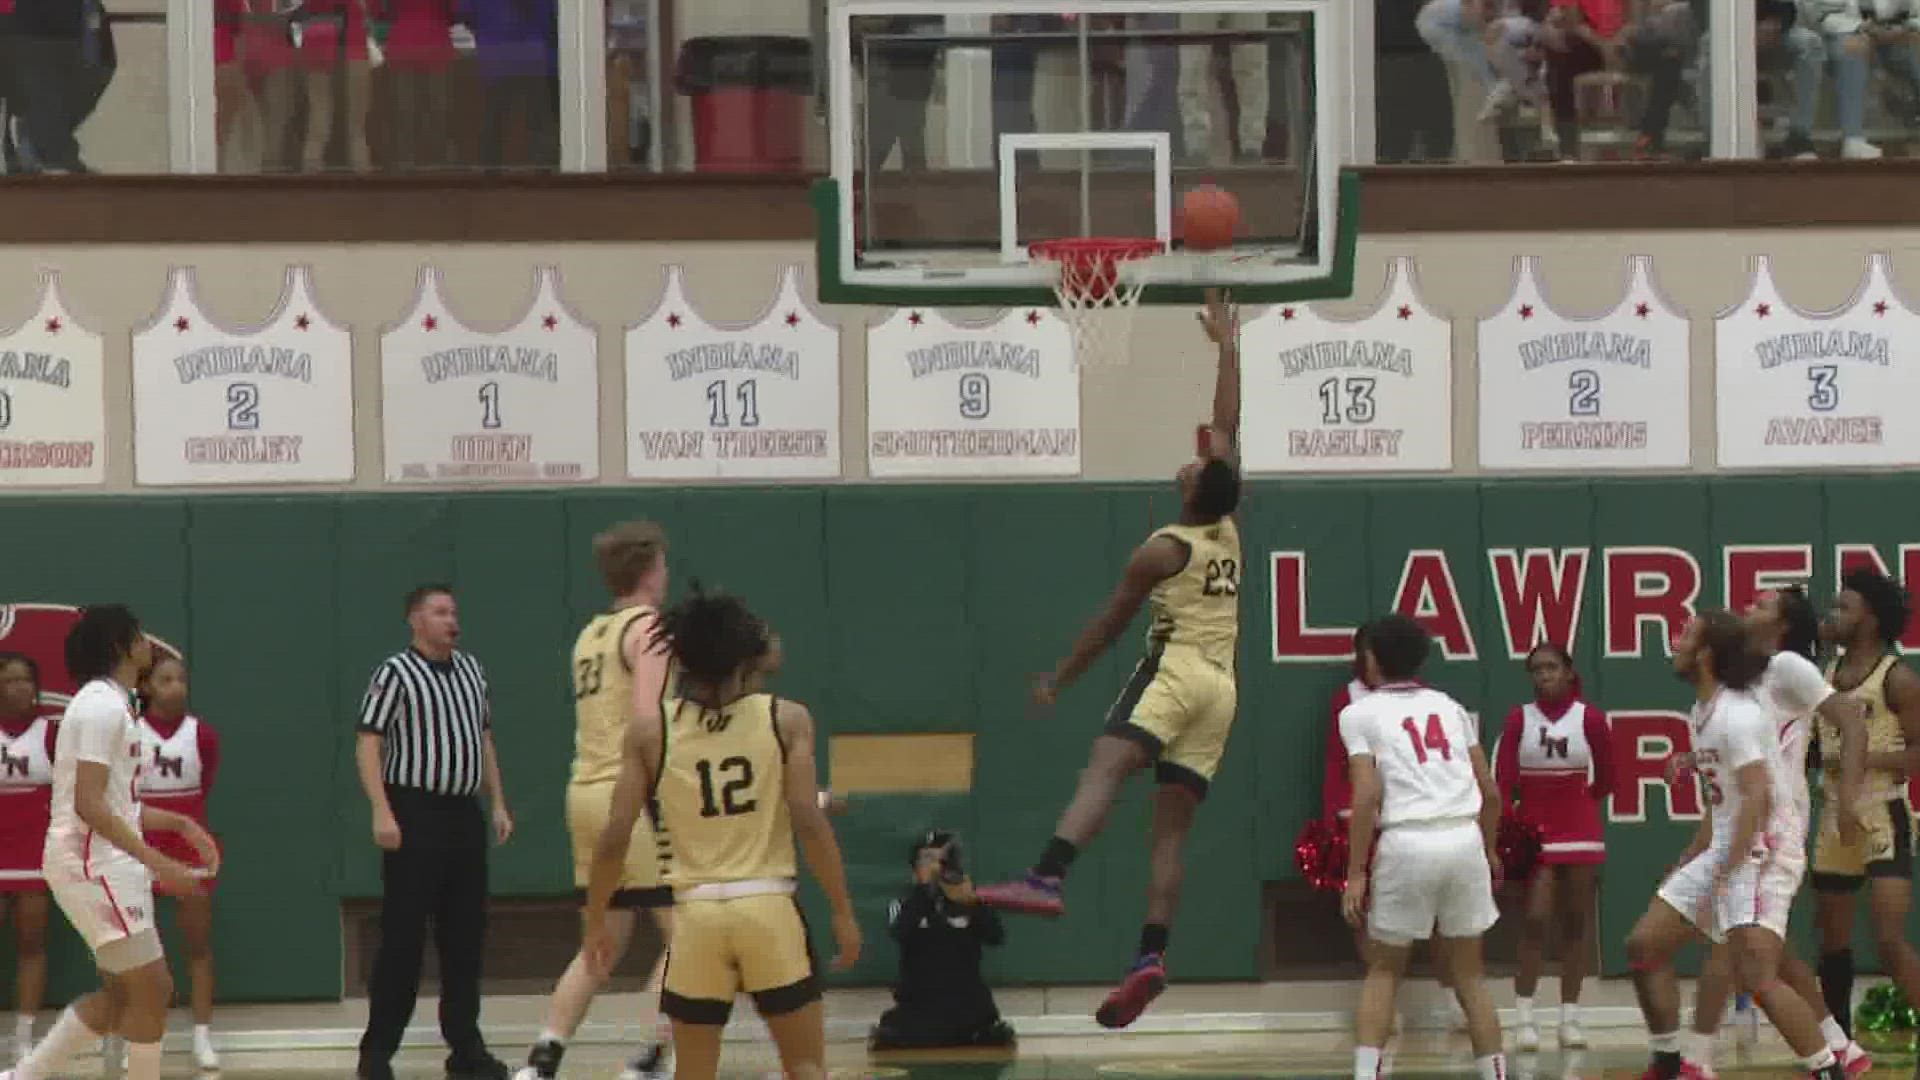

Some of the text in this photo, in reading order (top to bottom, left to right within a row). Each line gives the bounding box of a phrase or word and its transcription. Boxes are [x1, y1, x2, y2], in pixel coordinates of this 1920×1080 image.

[173, 345, 312, 384] INDIANA
[421, 344, 559, 384] INDIANA
[665, 341, 800, 381] INDIANA
[905, 340, 1040, 379] INDIANA
[1278, 340, 1414, 378] INDIANA
[1518, 330, 1652, 370] INDIANA
[1755, 330, 1889, 367] INDIANA
[228, 383, 260, 430] 2
[478, 381, 502, 429] 1
[706, 378, 761, 427] 11
[959, 372, 990, 419] 9
[1319, 376, 1377, 424] 13
[1569, 369, 1601, 416] 2
[1808, 365, 1839, 411] 3
[1288, 429, 1404, 457] EASLEY
[1764, 416, 1884, 445] AVANCE
[1203, 559, 1238, 596] 23
[1402, 714, 1452, 764] 14
[696, 756, 756, 817] 12
